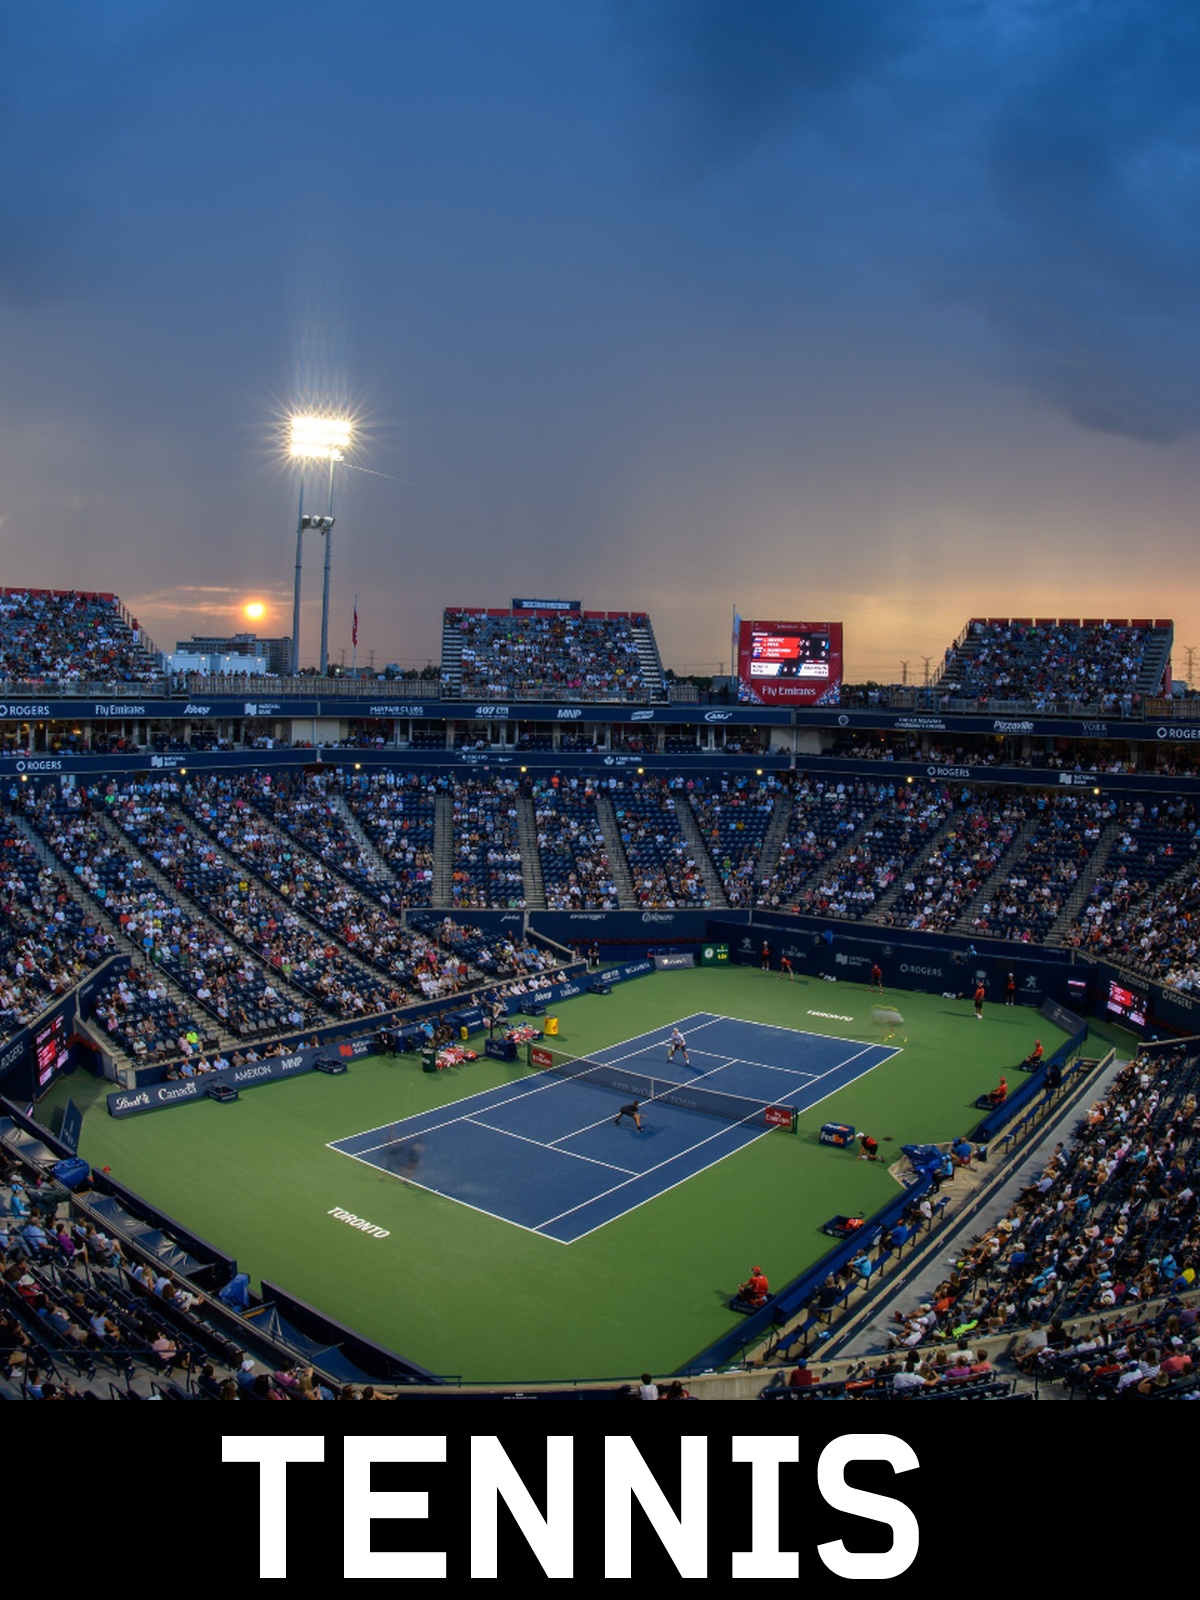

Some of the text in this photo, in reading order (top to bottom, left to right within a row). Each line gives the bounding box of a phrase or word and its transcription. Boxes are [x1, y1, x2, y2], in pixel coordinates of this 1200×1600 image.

[762, 686, 816, 696] Fly Emirates
[9, 705, 50, 716] ROGERS
[95, 704, 146, 716] Fly Emirates
[475, 706, 495, 715] 407
[994, 720, 1035, 731] Pizzaville
[27, 760, 62, 770] ROGERS
[937, 767, 970, 777] ROGERS
[909, 965, 943, 977] ROGERS
[234, 1056, 303, 1082] AMEXON MNP
[158, 1084, 197, 1101] Canada
[611, 1080, 629, 1091] ATP
[670, 1095, 698, 1109] TOUR
[820, 1131, 845, 1145] FedEx
[326, 1206, 391, 1238] TORONTO
